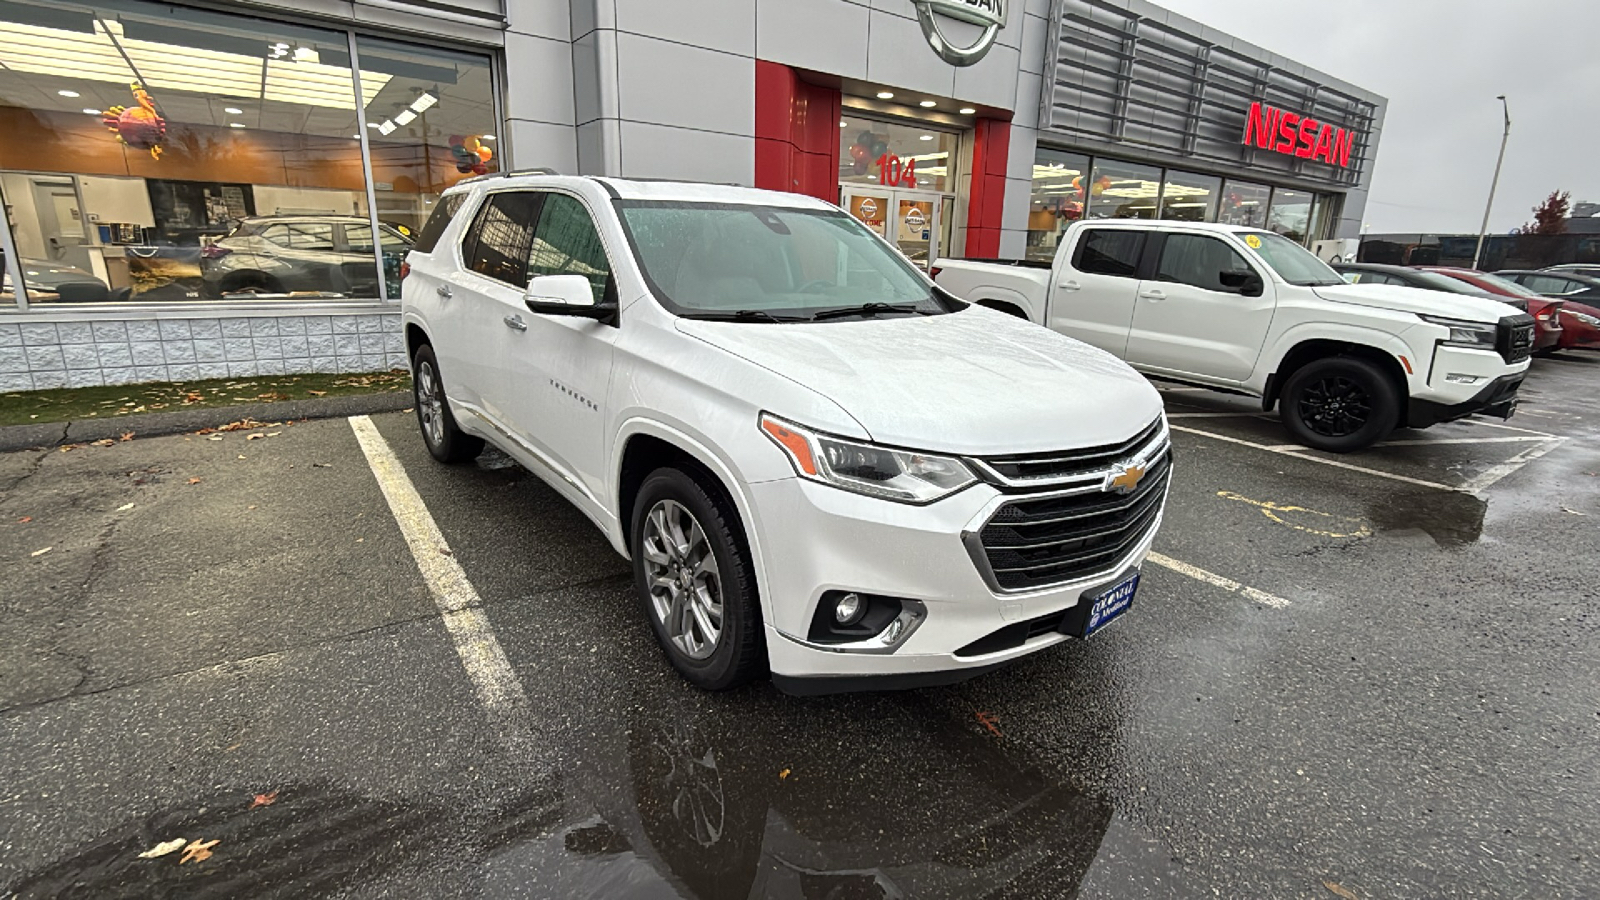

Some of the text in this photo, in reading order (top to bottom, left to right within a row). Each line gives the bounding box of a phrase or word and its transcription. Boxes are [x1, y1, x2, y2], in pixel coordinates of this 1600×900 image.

[1244, 102, 1354, 167] NISSAN
[876, 153, 917, 188] 104
[549, 379, 598, 411] TRAVERSE
